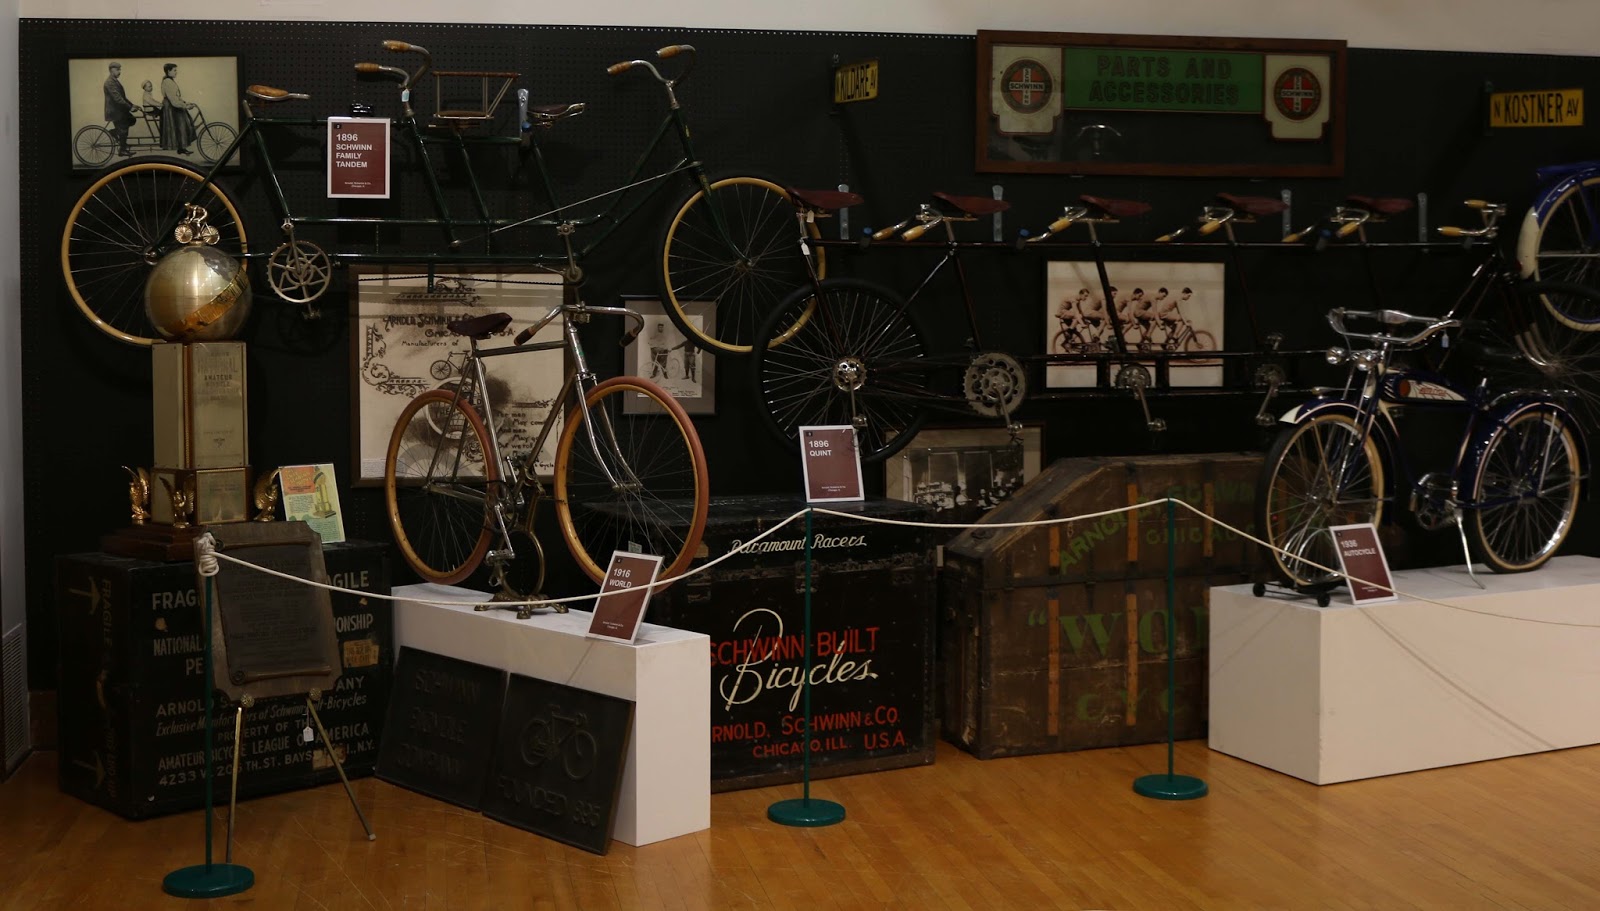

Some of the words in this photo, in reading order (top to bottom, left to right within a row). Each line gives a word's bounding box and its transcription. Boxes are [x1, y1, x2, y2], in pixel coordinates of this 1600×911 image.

[1097, 55, 1171, 78] PARTS
[1185, 57, 1232, 80] AND
[1089, 80, 1239, 105] ACCESSORIES
[1494, 100, 1500, 119] N
[1504, 93, 1563, 124] KOSTNER
[1566, 96, 1579, 118] AV
[336, 133, 358, 142] 1896
[336, 143, 372, 151] SCHWINN
[808, 440, 829, 448] 1896
[727, 535, 806, 554] Paramount
[810, 533, 868, 549] Racers
[1343, 548, 1377, 557] AUTOCYCLE
[613, 568, 632, 578] 1916
[609, 579, 632, 589] WORLD
[101, 576, 113, 649] FRAGILE
[153, 634, 203, 656] NATIONAL
[719, 608, 879, 712] Bicycles
[156, 718, 196, 737] Exclusive
[275, 721, 289, 733] OF
[158, 751, 205, 771] AMATEUR
[252, 735, 290, 754] LEAGUE
[159, 770, 197, 786] 4233
[357, 739, 375, 752] N.Y.
